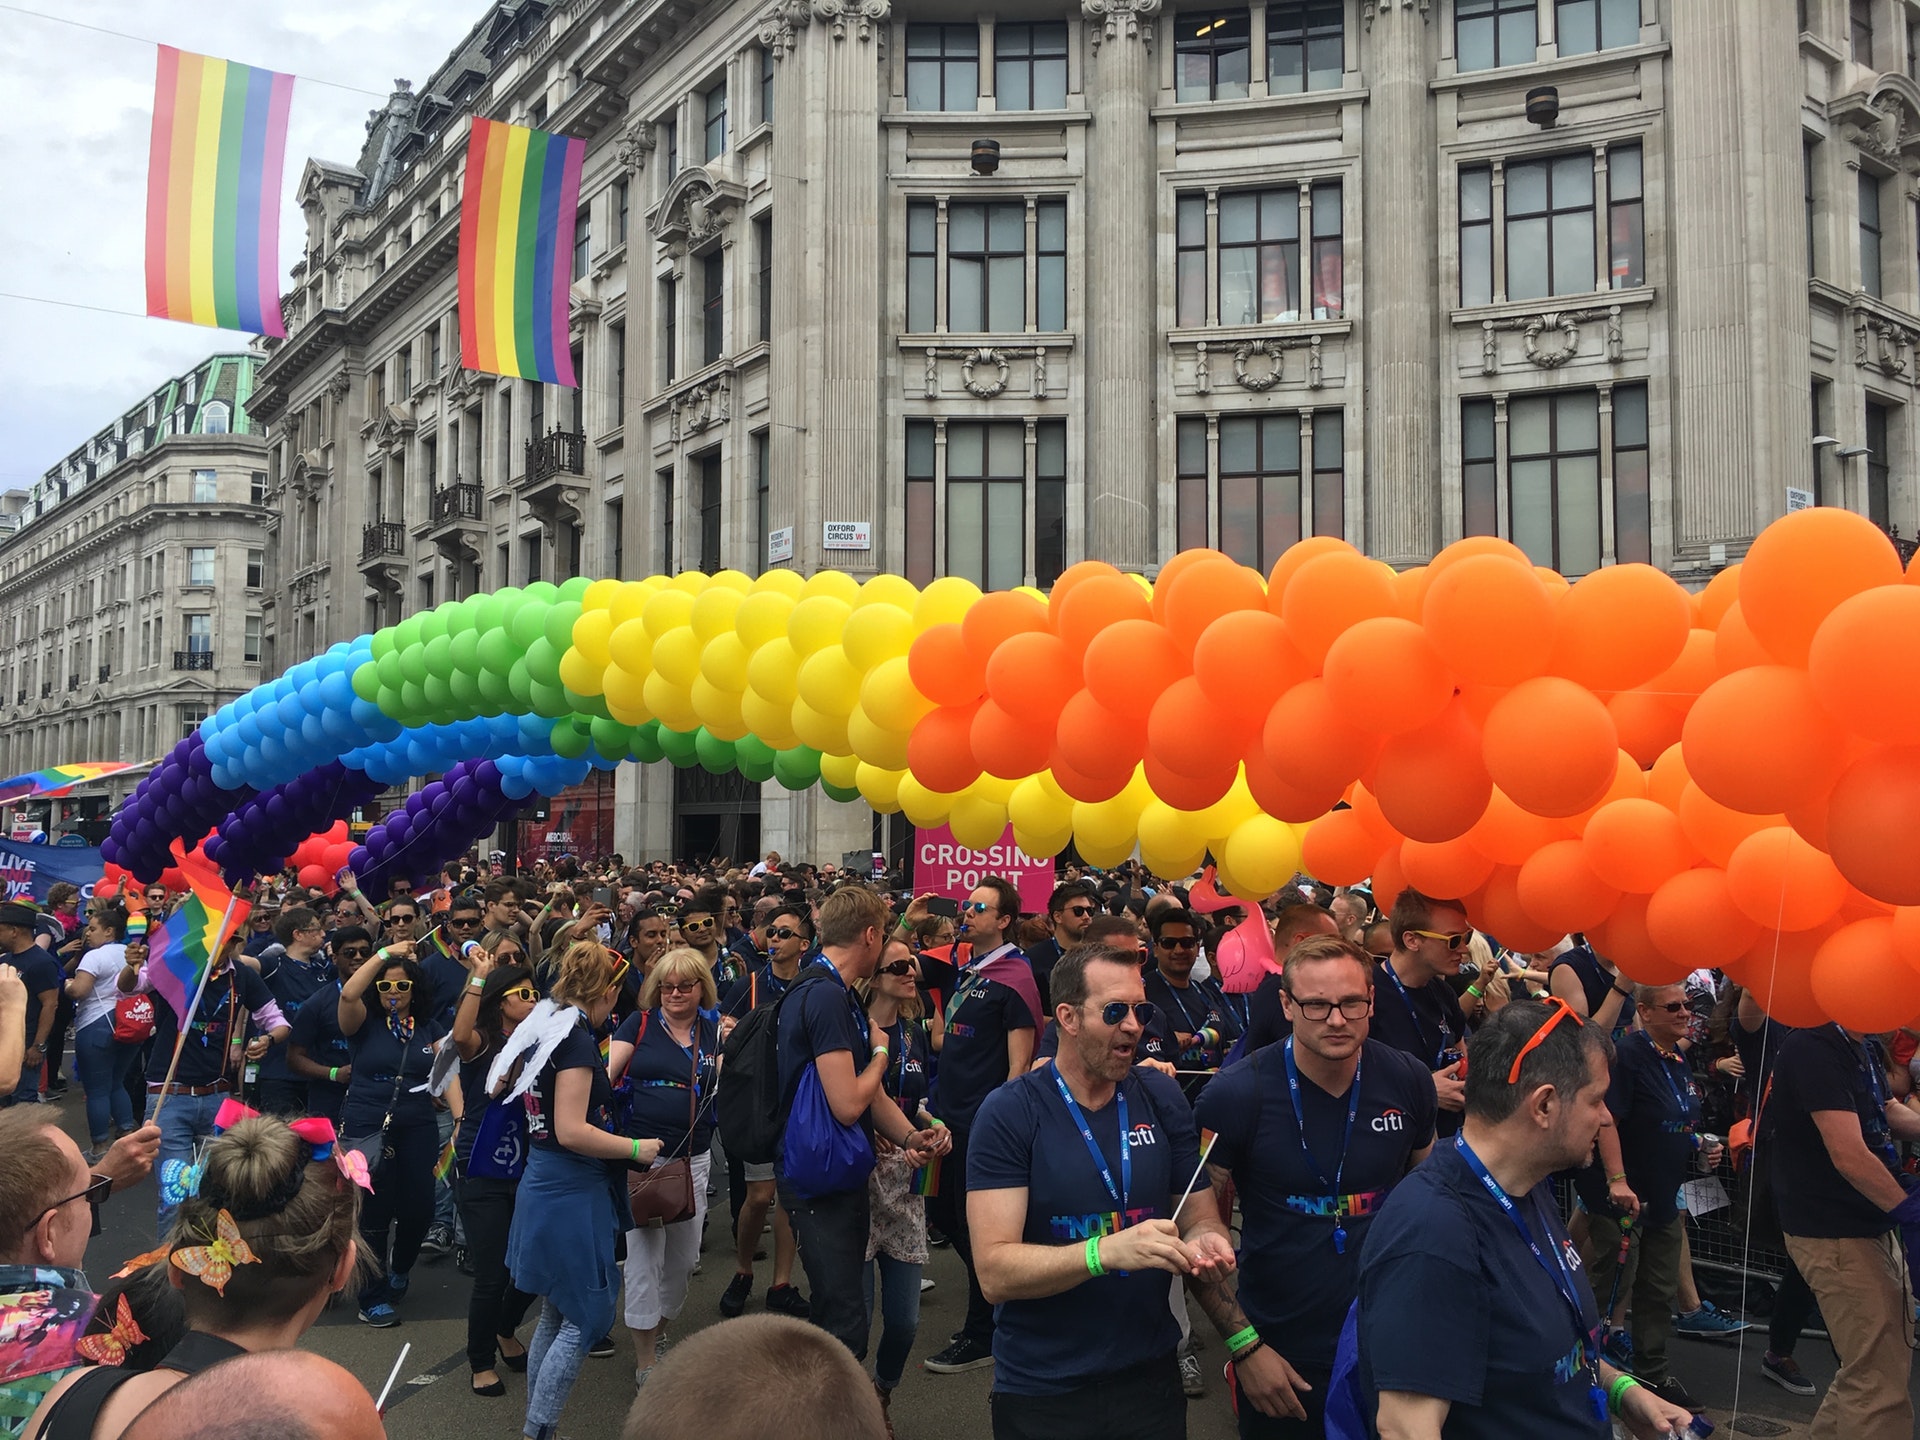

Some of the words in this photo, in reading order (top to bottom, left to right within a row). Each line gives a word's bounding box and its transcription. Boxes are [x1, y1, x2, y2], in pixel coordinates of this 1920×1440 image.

[827, 524, 856, 532] OXFORD
[0, 852, 36, 872] LIVE
[946, 869, 1023, 891] POT
[970, 988, 987, 999] citi
[1146, 1037, 1162, 1053] citi
[905, 1059, 922, 1073] citi
[1371, 1108, 1403, 1132] citi
[1128, 1123, 1156, 1147] citi
[1286, 1192, 1385, 1216] #NOFILT
